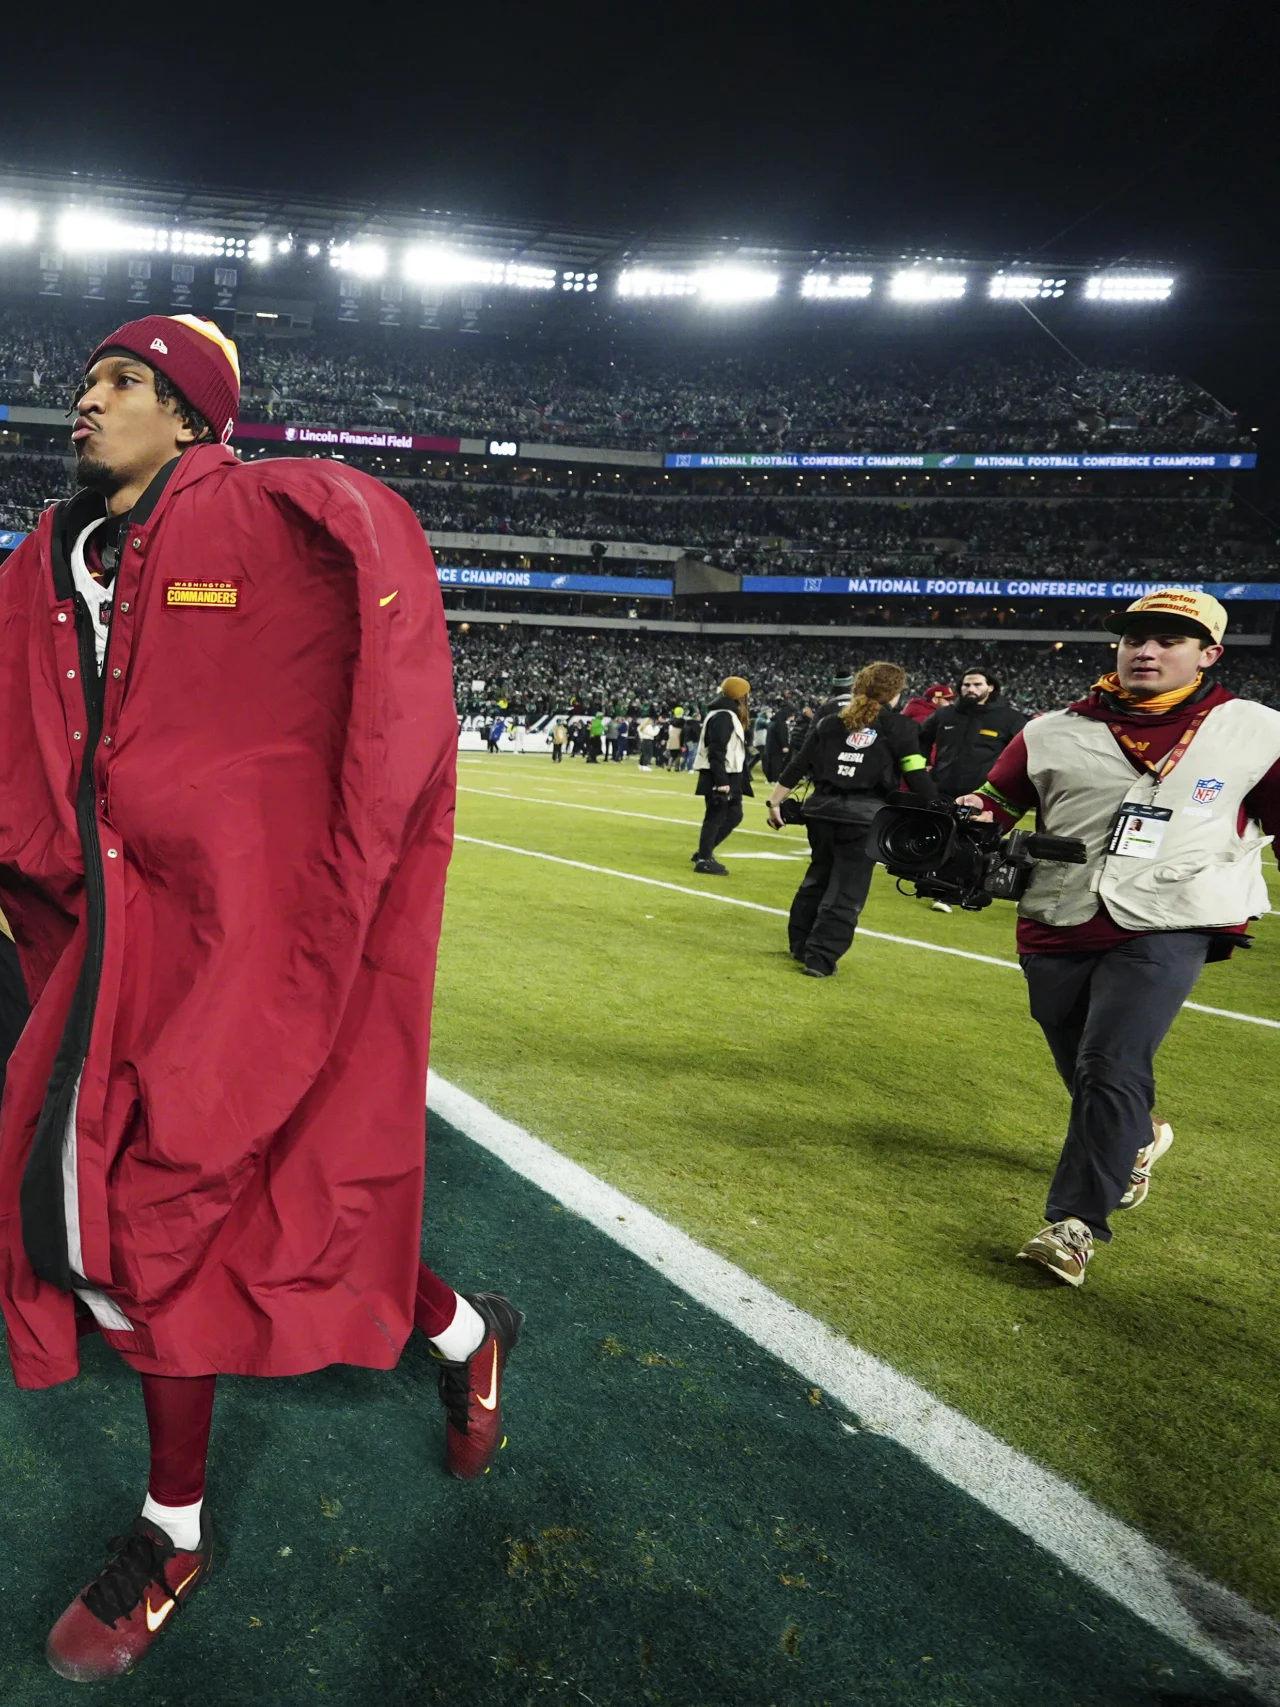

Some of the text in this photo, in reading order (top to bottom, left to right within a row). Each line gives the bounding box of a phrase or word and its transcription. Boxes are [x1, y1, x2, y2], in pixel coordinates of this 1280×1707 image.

[299, 429, 413, 449] Lincoln Financial Field
[701, 455, 924, 467] NATIONAL FOOTBALL CONFERENCE CHAMPIONS
[975, 456, 1215, 467] NATIONAL FOOTBALL CONFERENCE CHAMPIONS
[461, 570, 531, 586] CHAMPIONS
[848, 579, 920, 593] NATIONAL
[926, 580, 1001, 594] FOOTBALL
[1007, 582, 1106, 596] CONFERENCE
[167, 590, 237, 604] COMMANDERS
[851, 733, 871, 745] NFL
[1195, 788, 1216, 801] NFL
